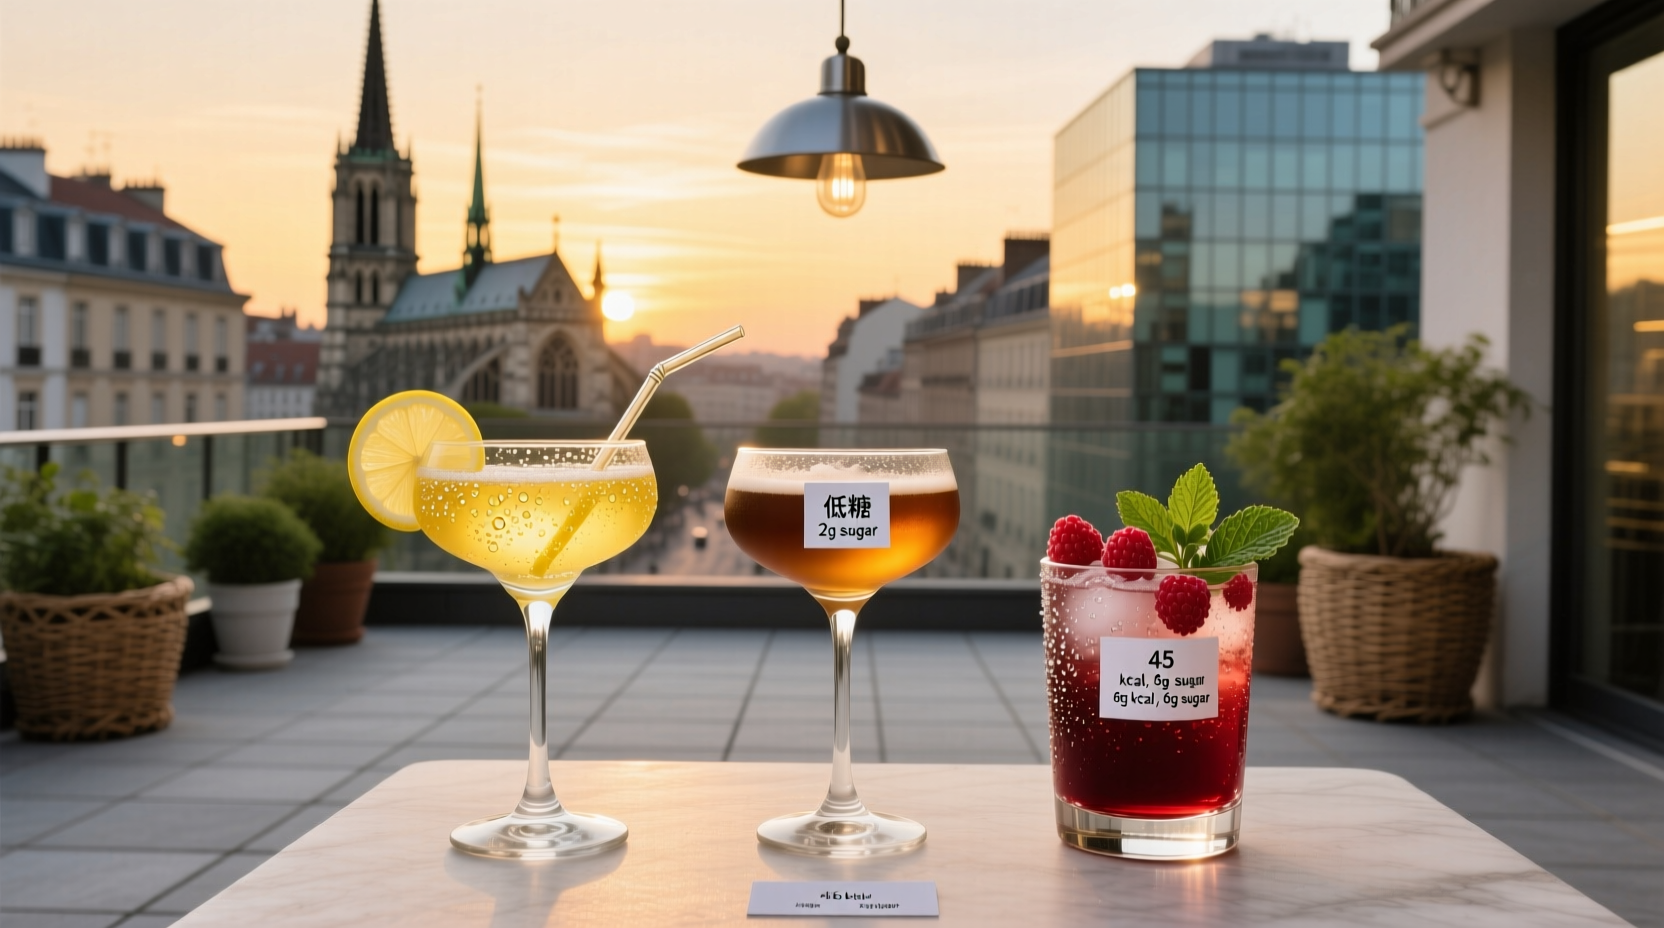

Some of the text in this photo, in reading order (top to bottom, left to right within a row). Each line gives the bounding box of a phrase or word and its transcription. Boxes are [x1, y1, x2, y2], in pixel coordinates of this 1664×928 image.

[824, 494, 872, 519] 低糖
[818, 522, 879, 541] 2g sugar
[1148, 649, 1175, 669] 45
[1119, 673, 1149, 689] kcal,
[1153, 673, 1170, 690] 6g
[1113, 691, 1128, 707] 6g
[1163, 692, 1179, 708] 6g
[1181, 694, 1211, 708] sugar
